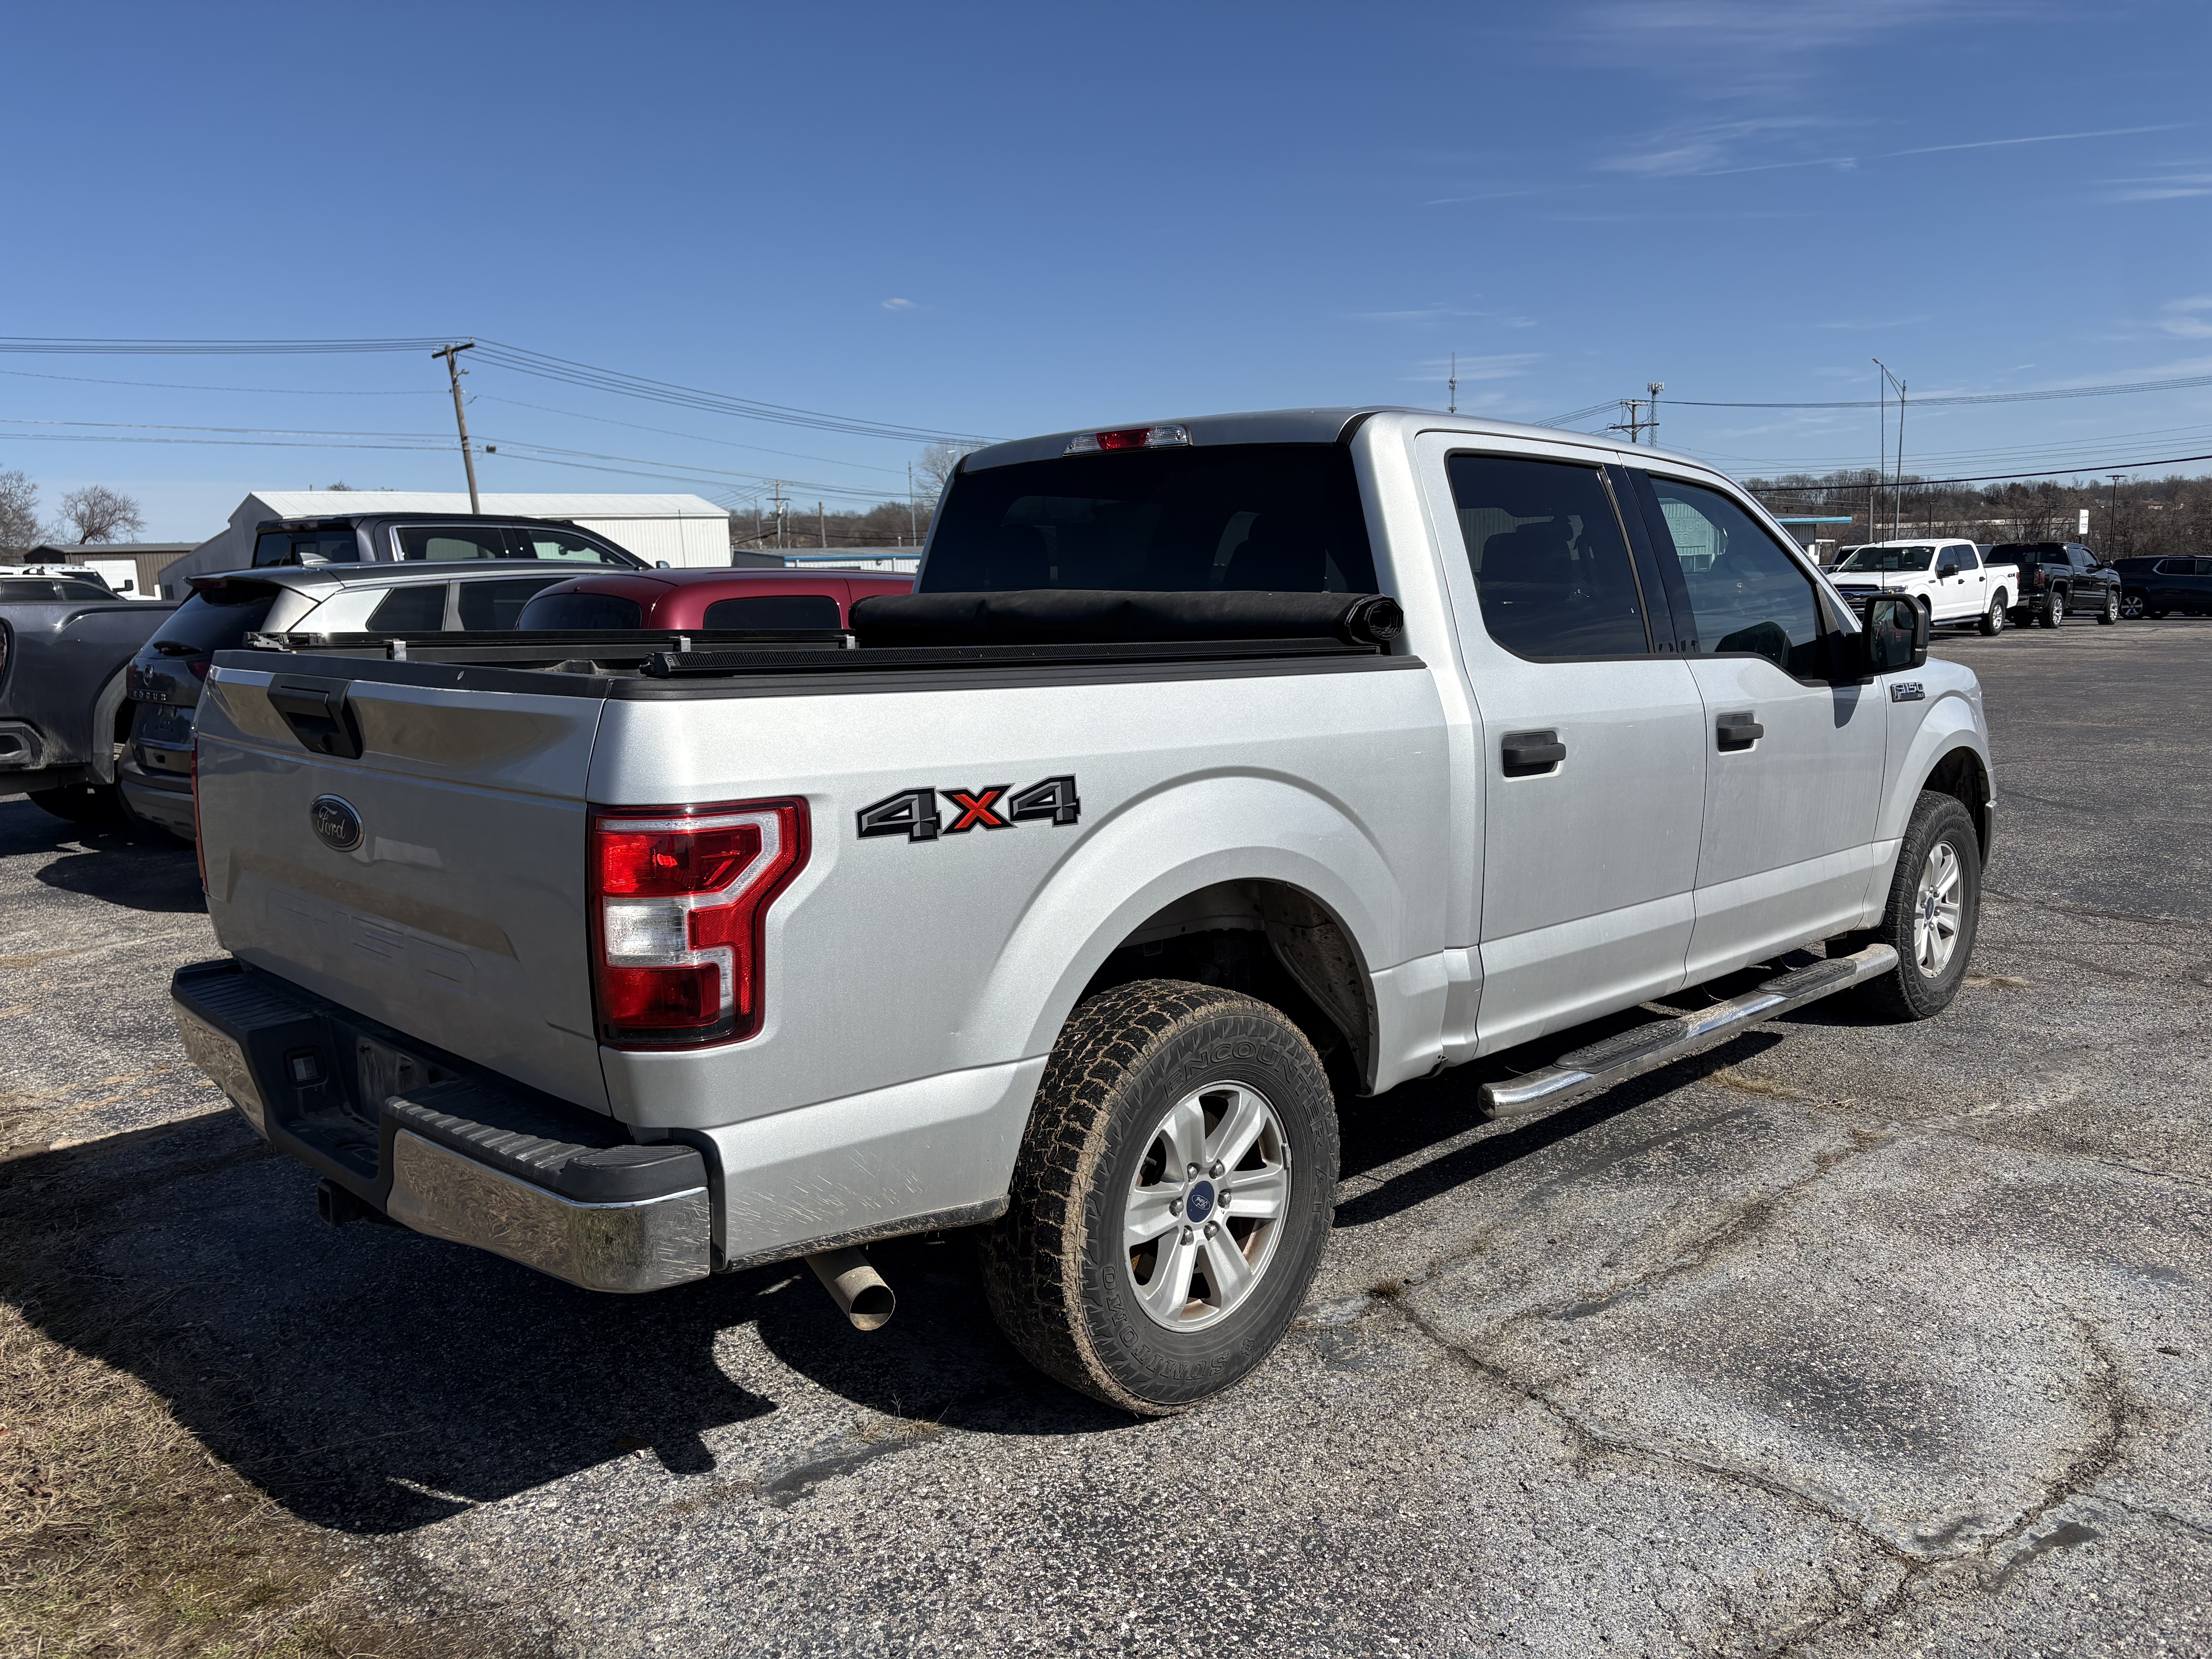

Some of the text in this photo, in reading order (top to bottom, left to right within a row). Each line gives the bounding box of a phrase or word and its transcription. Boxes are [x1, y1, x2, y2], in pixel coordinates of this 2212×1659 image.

[317, 806, 346, 839] Ford
[1163, 1041, 1326, 1154] ENCOUNTER
[1102, 1266, 1229, 1380] SUMITOMO
